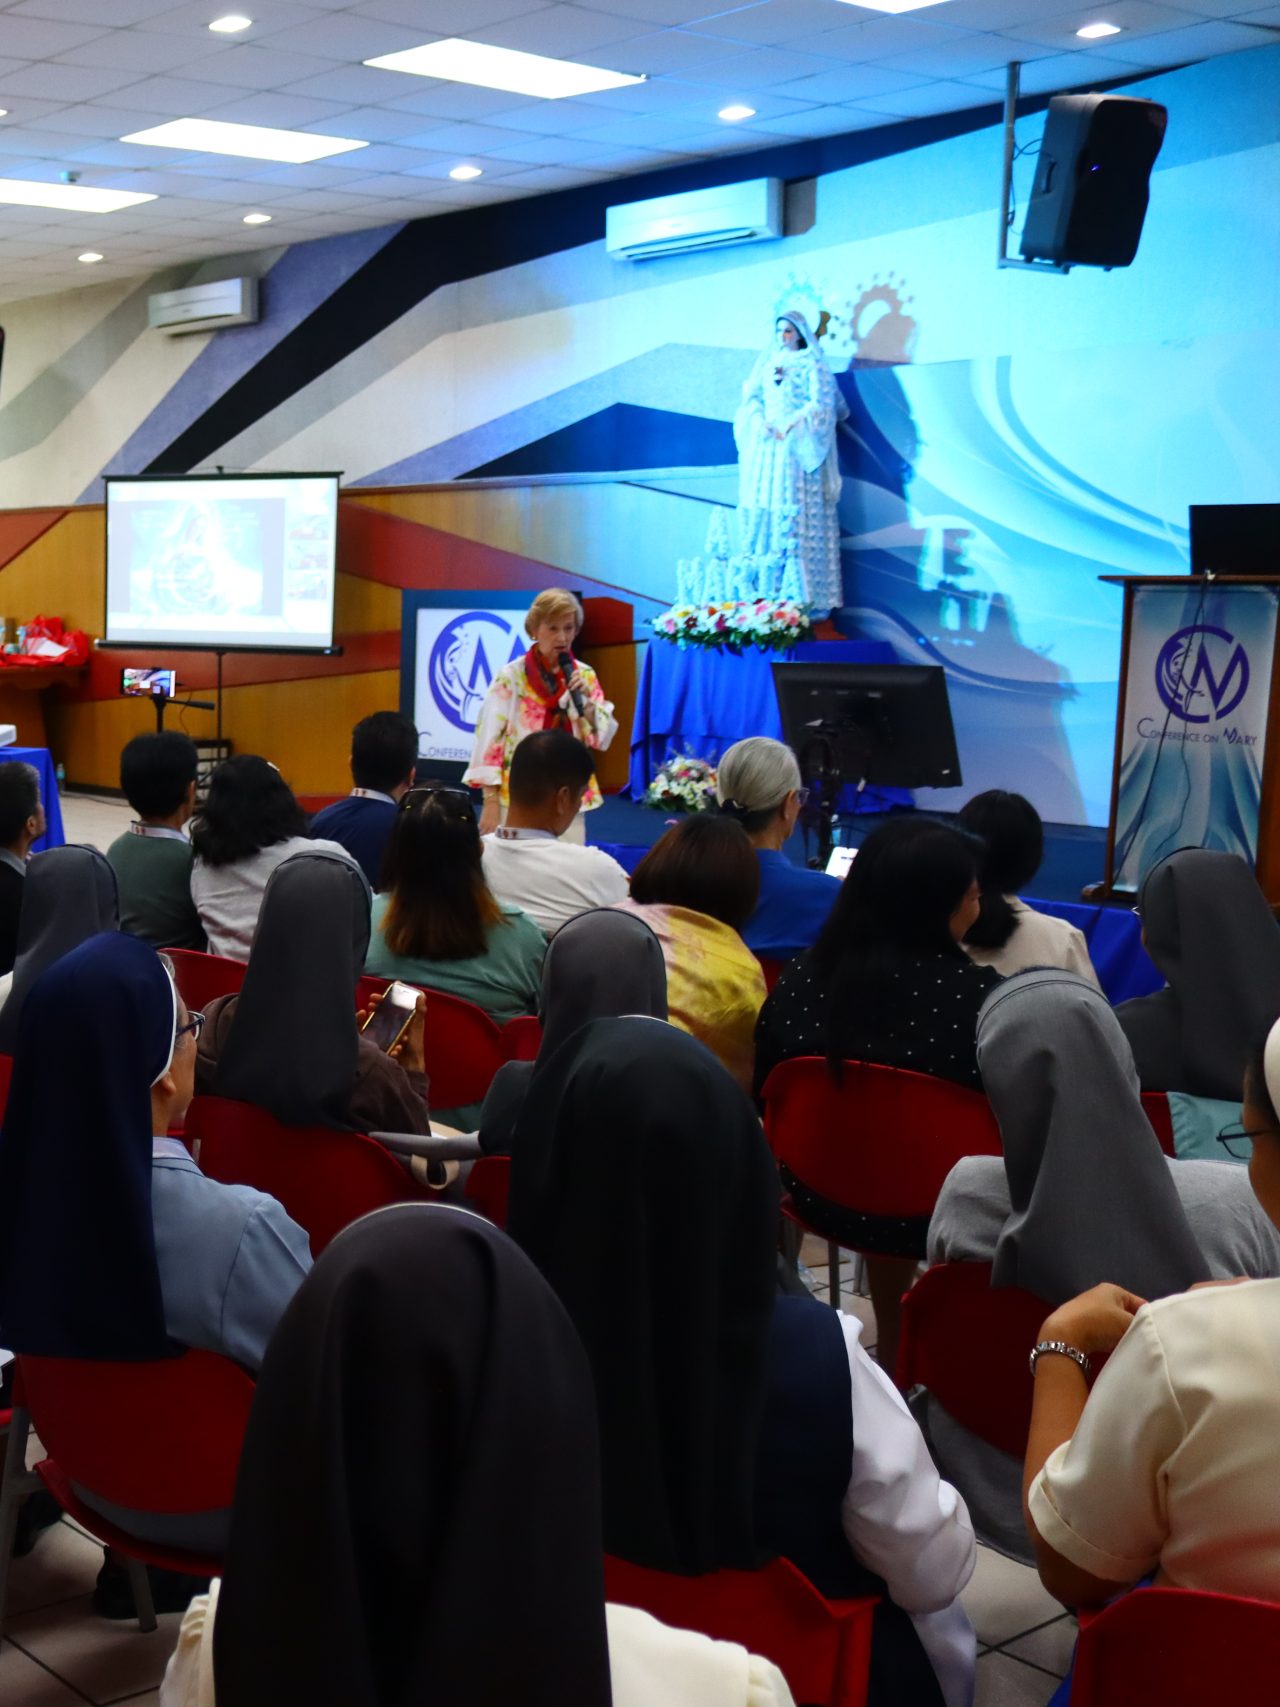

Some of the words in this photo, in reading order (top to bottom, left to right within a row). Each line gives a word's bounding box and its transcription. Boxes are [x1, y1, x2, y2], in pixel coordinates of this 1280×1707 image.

[676, 556, 812, 605] MARIA
[417, 731, 473, 759] CONFEREN
[1136, 717, 1200, 742] CONFERENCE
[1203, 734, 1219, 743] ON
[1224, 727, 1258, 745] MARY
